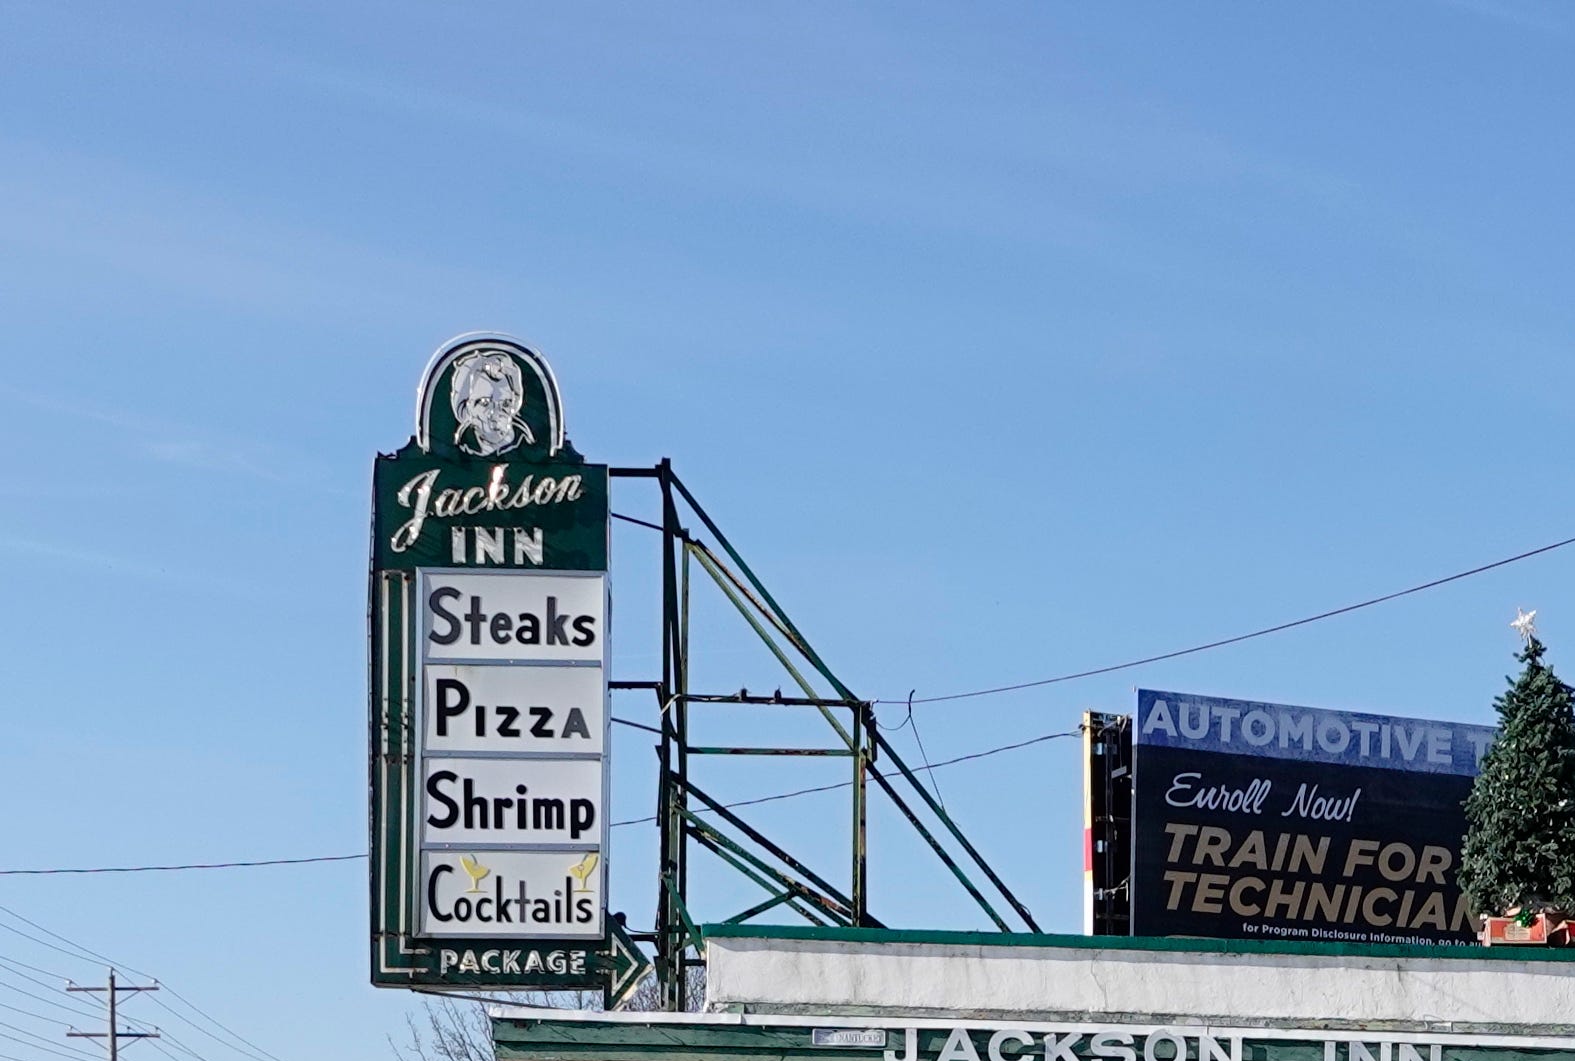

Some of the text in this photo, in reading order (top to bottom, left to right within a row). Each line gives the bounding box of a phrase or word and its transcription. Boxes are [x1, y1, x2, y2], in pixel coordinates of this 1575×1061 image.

[391, 463, 584, 552] Jackson
[452, 525, 544, 565] INN
[428, 586, 597, 647] Steaks
[1142, 699, 1454, 764] AUTOMOTIVE
[426, 770, 596, 839] Shrimp
[1165, 772, 1361, 821] Enroll Now!
[1163, 823, 1331, 875] TRAIN
[1342, 839, 1452, 885] FOR
[428, 864, 593, 924] Cocktails
[440, 948, 586, 976] PACKAGE
[1243, 922, 1258, 934] for
[1262, 925, 1308, 938] Program
[1311, 928, 1367, 942] Disclosure
[1370, 932, 1435, 947] Information,
